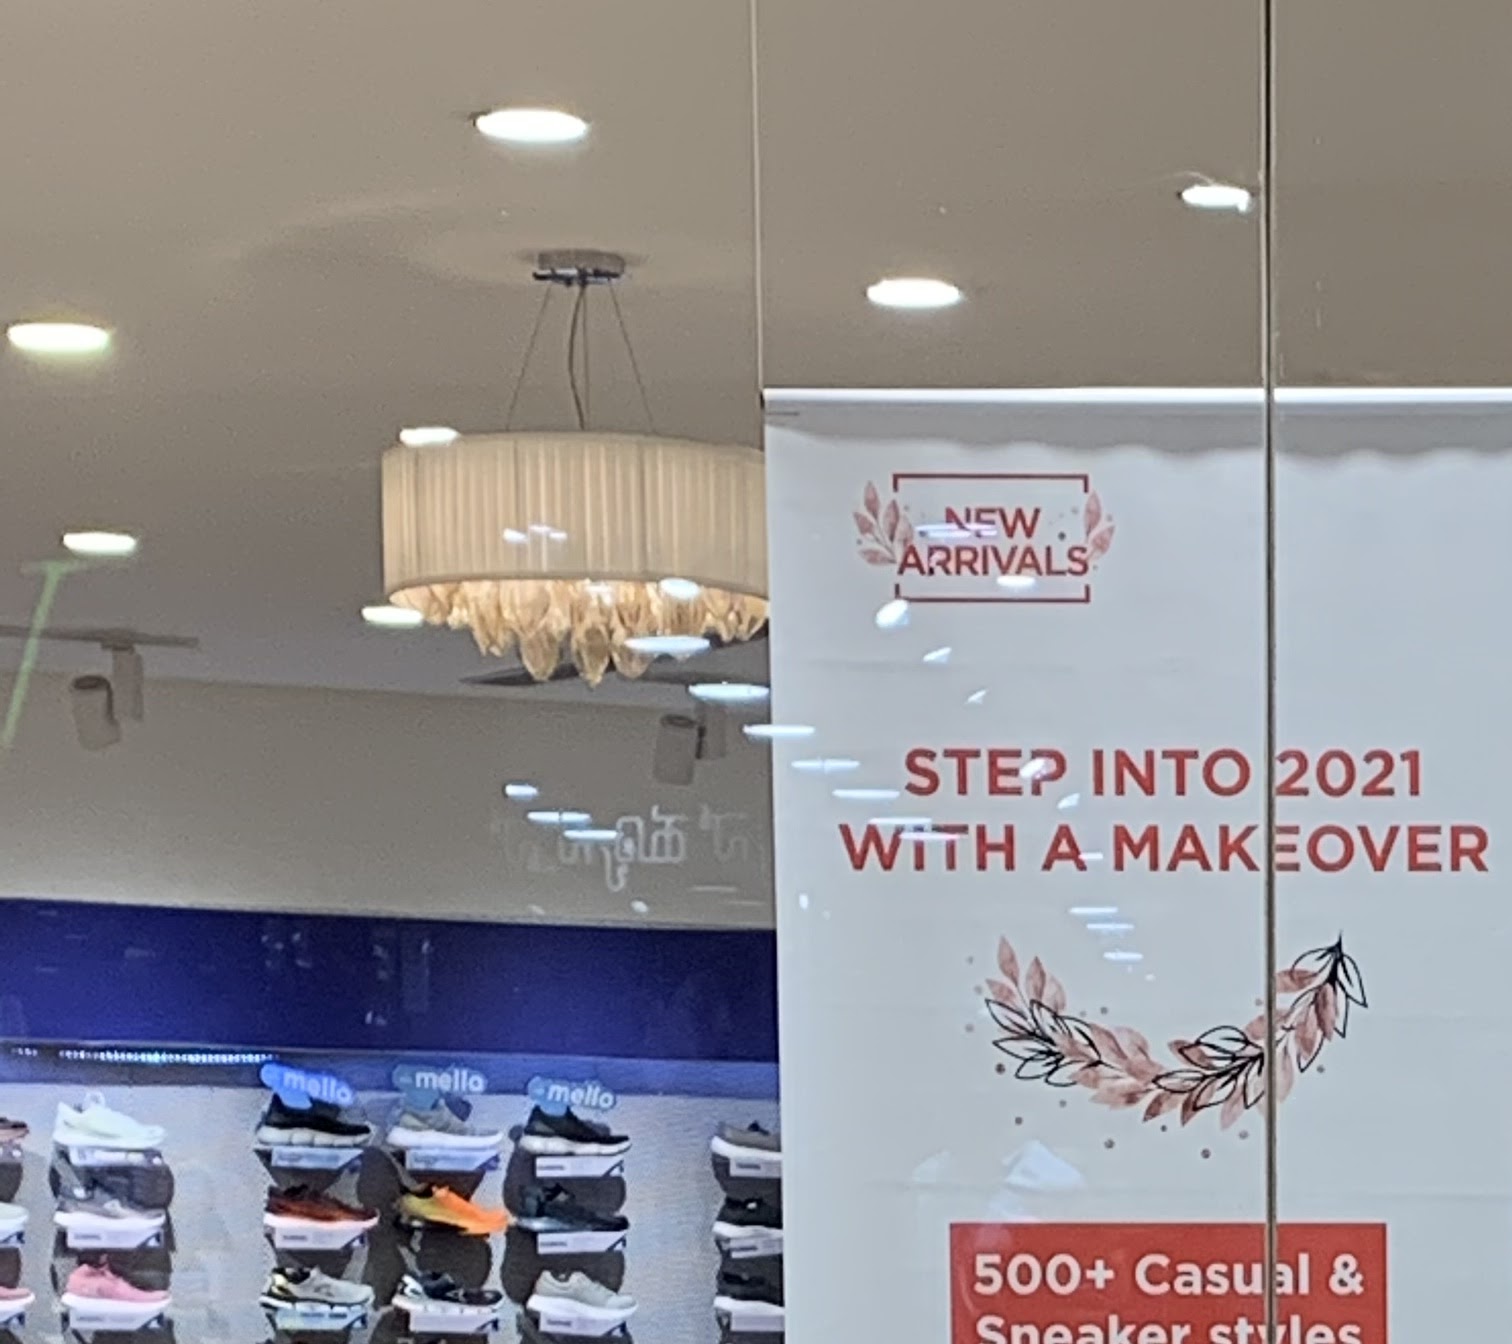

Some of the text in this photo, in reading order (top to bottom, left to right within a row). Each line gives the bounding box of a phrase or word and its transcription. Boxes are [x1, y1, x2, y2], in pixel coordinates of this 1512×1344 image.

[944, 507, 1042, 538] NEW
[896, 544, 1090, 578] ARRIVALS
[903, 747, 1423, 797] STEP INTO 2021
[839, 823, 1491, 873] WITH A MAKEOVER
[283, 1069, 354, 1106] mello
[415, 1068, 485, 1093] mello
[546, 1081, 616, 1110] mello
[972, 1252, 1364, 1297] 500+ Casual &
